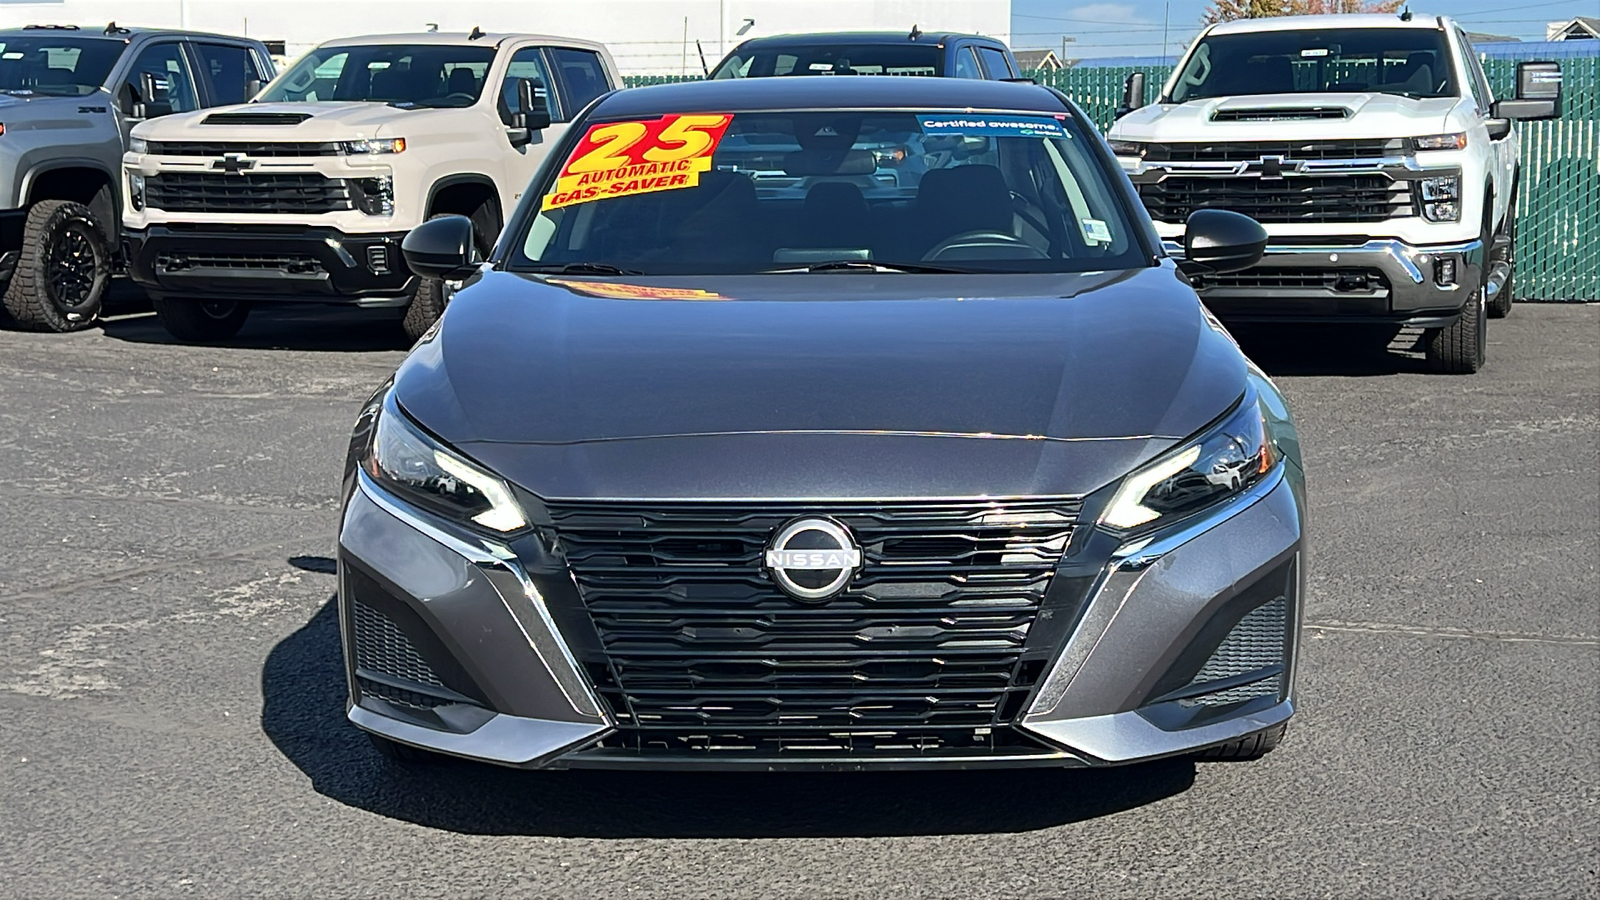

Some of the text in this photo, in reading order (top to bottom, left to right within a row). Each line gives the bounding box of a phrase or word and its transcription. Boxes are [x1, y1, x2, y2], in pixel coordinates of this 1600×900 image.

[924, 120, 1060, 131] Certified awesome.
[568, 114, 728, 174] 25
[577, 160, 691, 187] AUTOMATIC
[551, 174, 689, 206] GAS-SAVER
[768, 553, 857, 567] NISSAN
